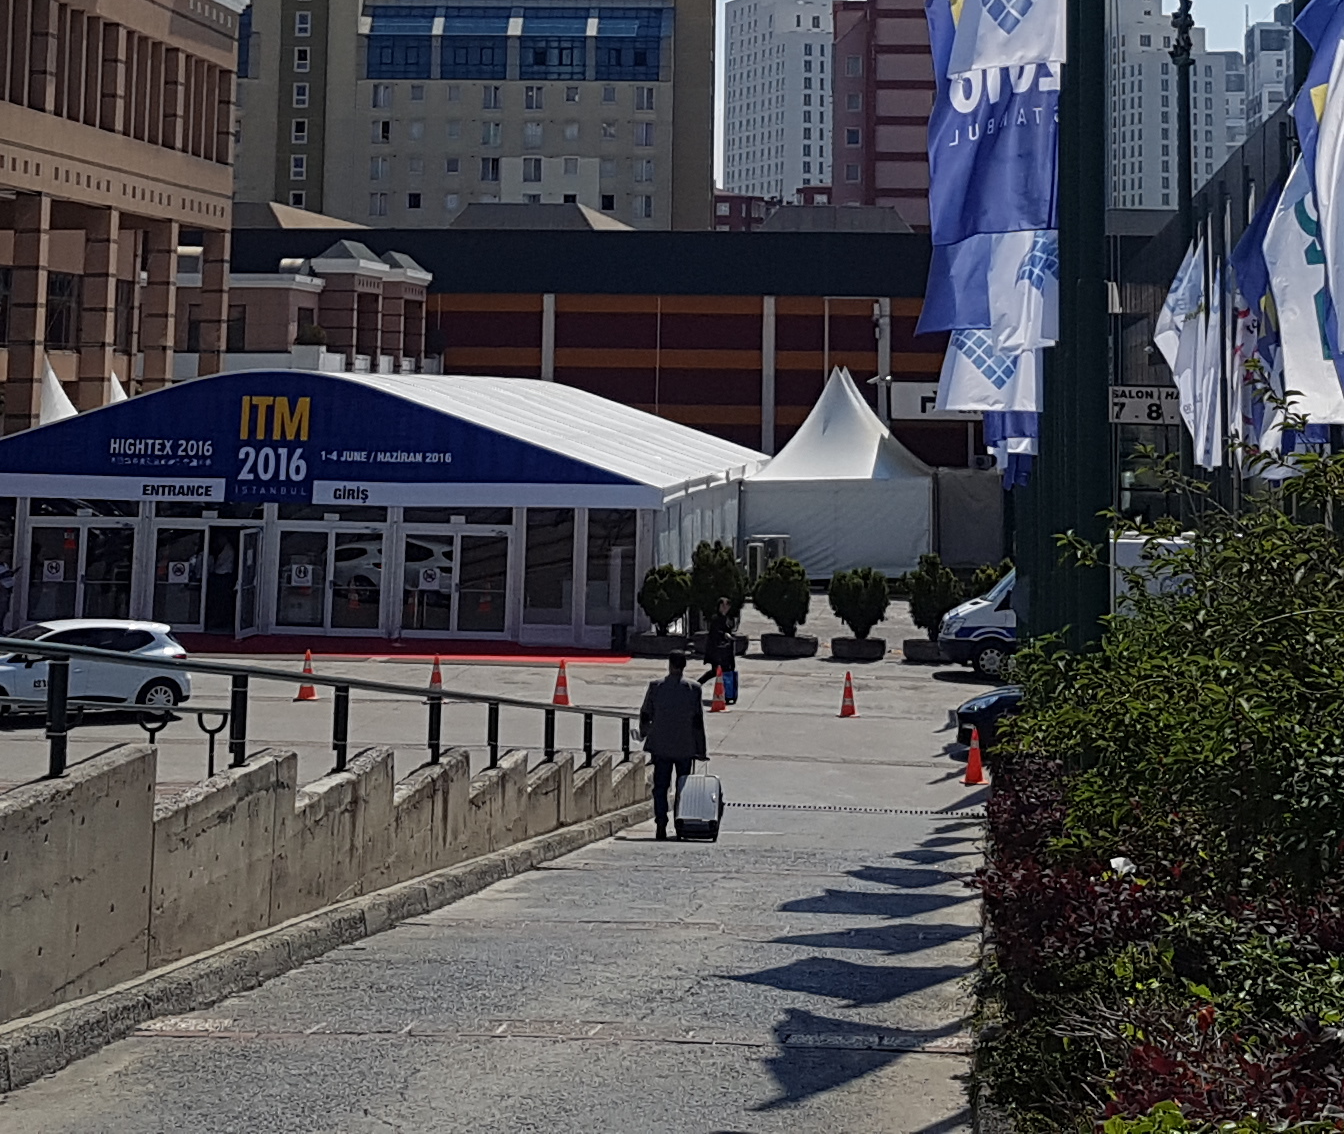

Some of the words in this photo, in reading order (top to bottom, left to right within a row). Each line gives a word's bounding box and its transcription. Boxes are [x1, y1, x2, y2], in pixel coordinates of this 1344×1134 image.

[239, 395, 311, 441] ITM
[1147, 403, 1161, 420] 8
[110, 438, 173, 455] HIGHTEX
[177, 439, 213, 456] 2016
[320, 451, 338, 462] 1-4
[340, 451, 367, 463] JUNE
[377, 449, 423, 463] HAZİRAN
[425, 452, 452, 463] 2016
[237, 446, 307, 482] 2016
[142, 483, 213, 497] ENTRANCE
[333, 484, 369, 503] GİRİŞ
